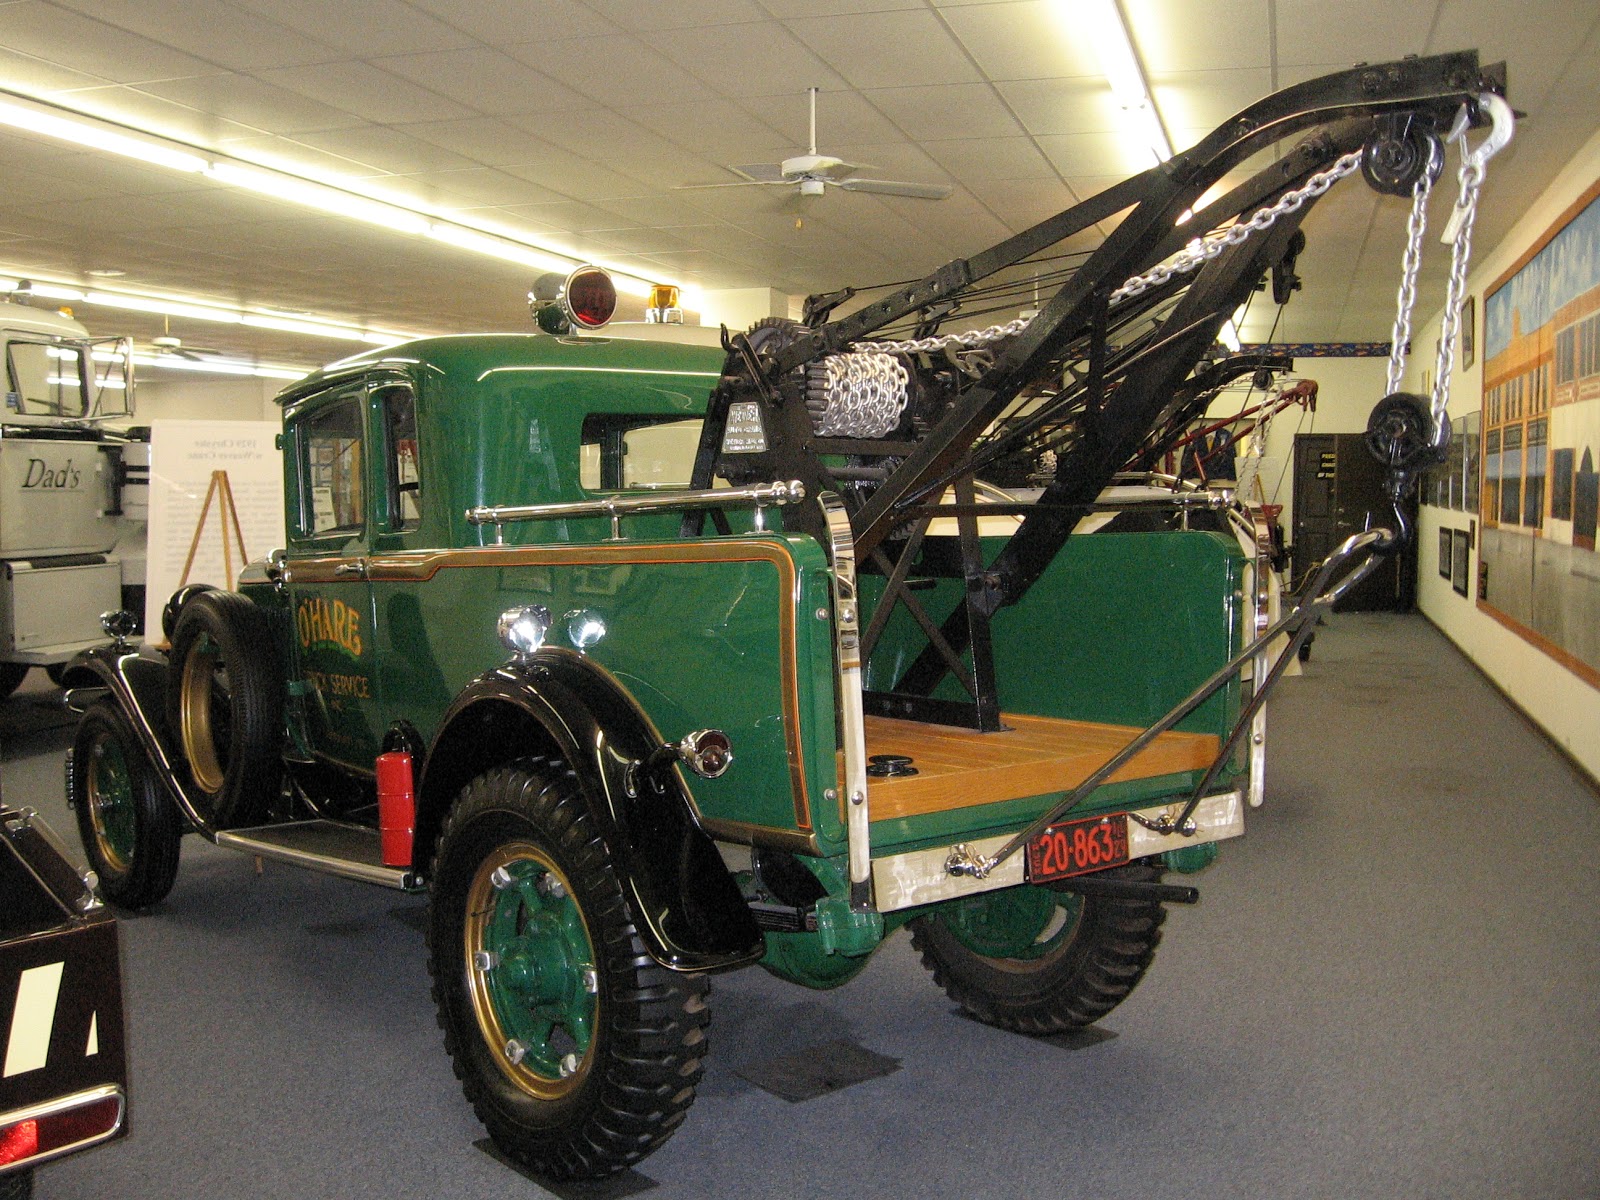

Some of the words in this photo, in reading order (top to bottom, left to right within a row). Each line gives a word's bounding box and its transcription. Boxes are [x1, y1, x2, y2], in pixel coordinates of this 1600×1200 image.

[21, 458, 80, 488] Dad's
[298, 597, 363, 656] O'HARE
[330, 673, 371, 698] SERVICE
